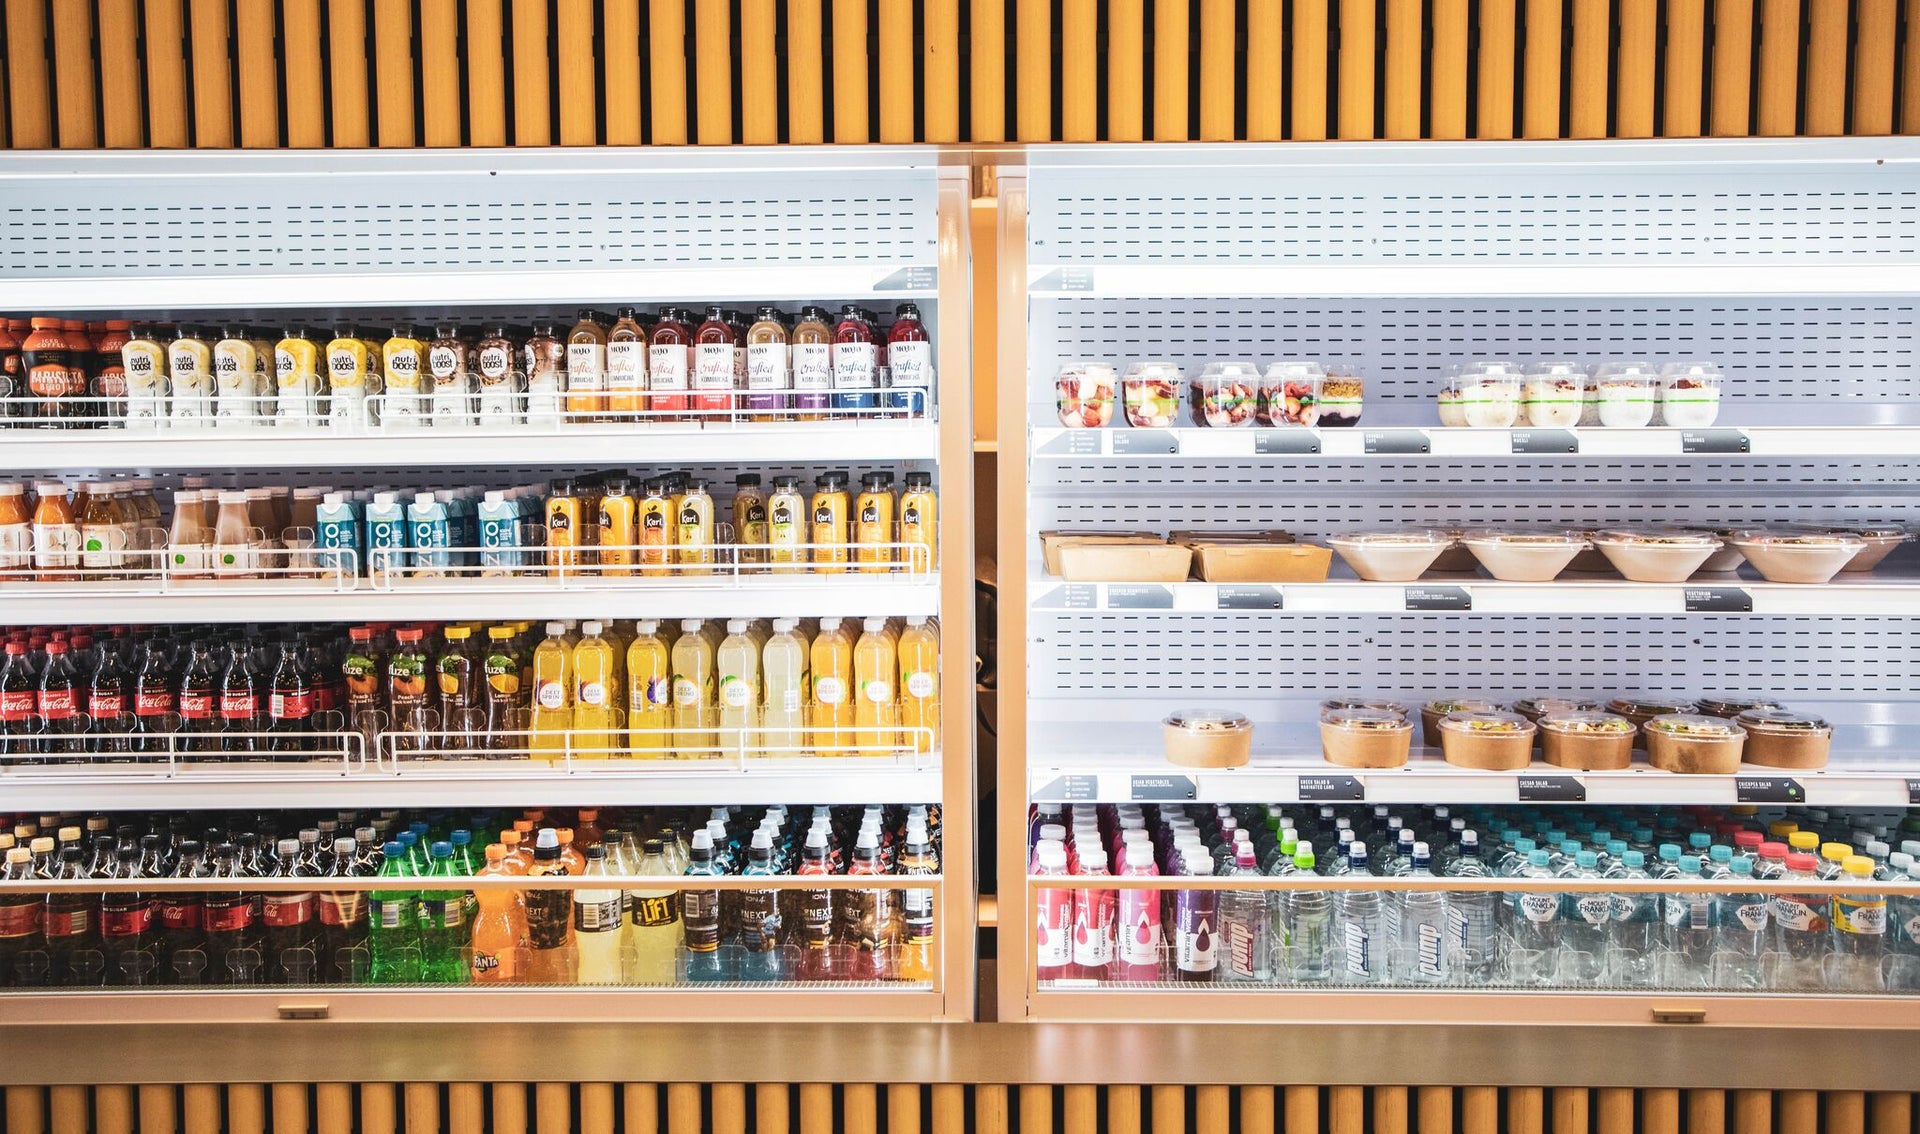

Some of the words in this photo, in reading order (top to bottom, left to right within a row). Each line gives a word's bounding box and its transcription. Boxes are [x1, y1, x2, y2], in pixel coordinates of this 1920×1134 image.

[130, 362, 151, 371] boost
[332, 361, 354, 370] boost
[392, 361, 417, 370] boost
[432, 360, 452, 368] boost
[482, 360, 502, 369] boost
[552, 517, 567, 527] Keri
[647, 517, 662, 527] Keri
[682, 514, 697, 523] Keri
[774, 513, 790, 523] Keri
[816, 512, 832, 522] Keri
[864, 512, 878, 522] Keri
[906, 513, 919, 523] Keri
[343, 664, 362, 674] fuze
[389, 664, 409, 676] fuze
[484, 664, 505, 674] fuze
[1523, 899, 1556, 909] FRANKLIN
[745, 911, 767, 919] NEXT
[810, 907, 832, 917] NEXT
[1230, 922, 1254, 978] pump
[1345, 921, 1370, 977] pump
[1418, 922, 1442, 976] pump
[474, 955, 498, 967] FANTA
